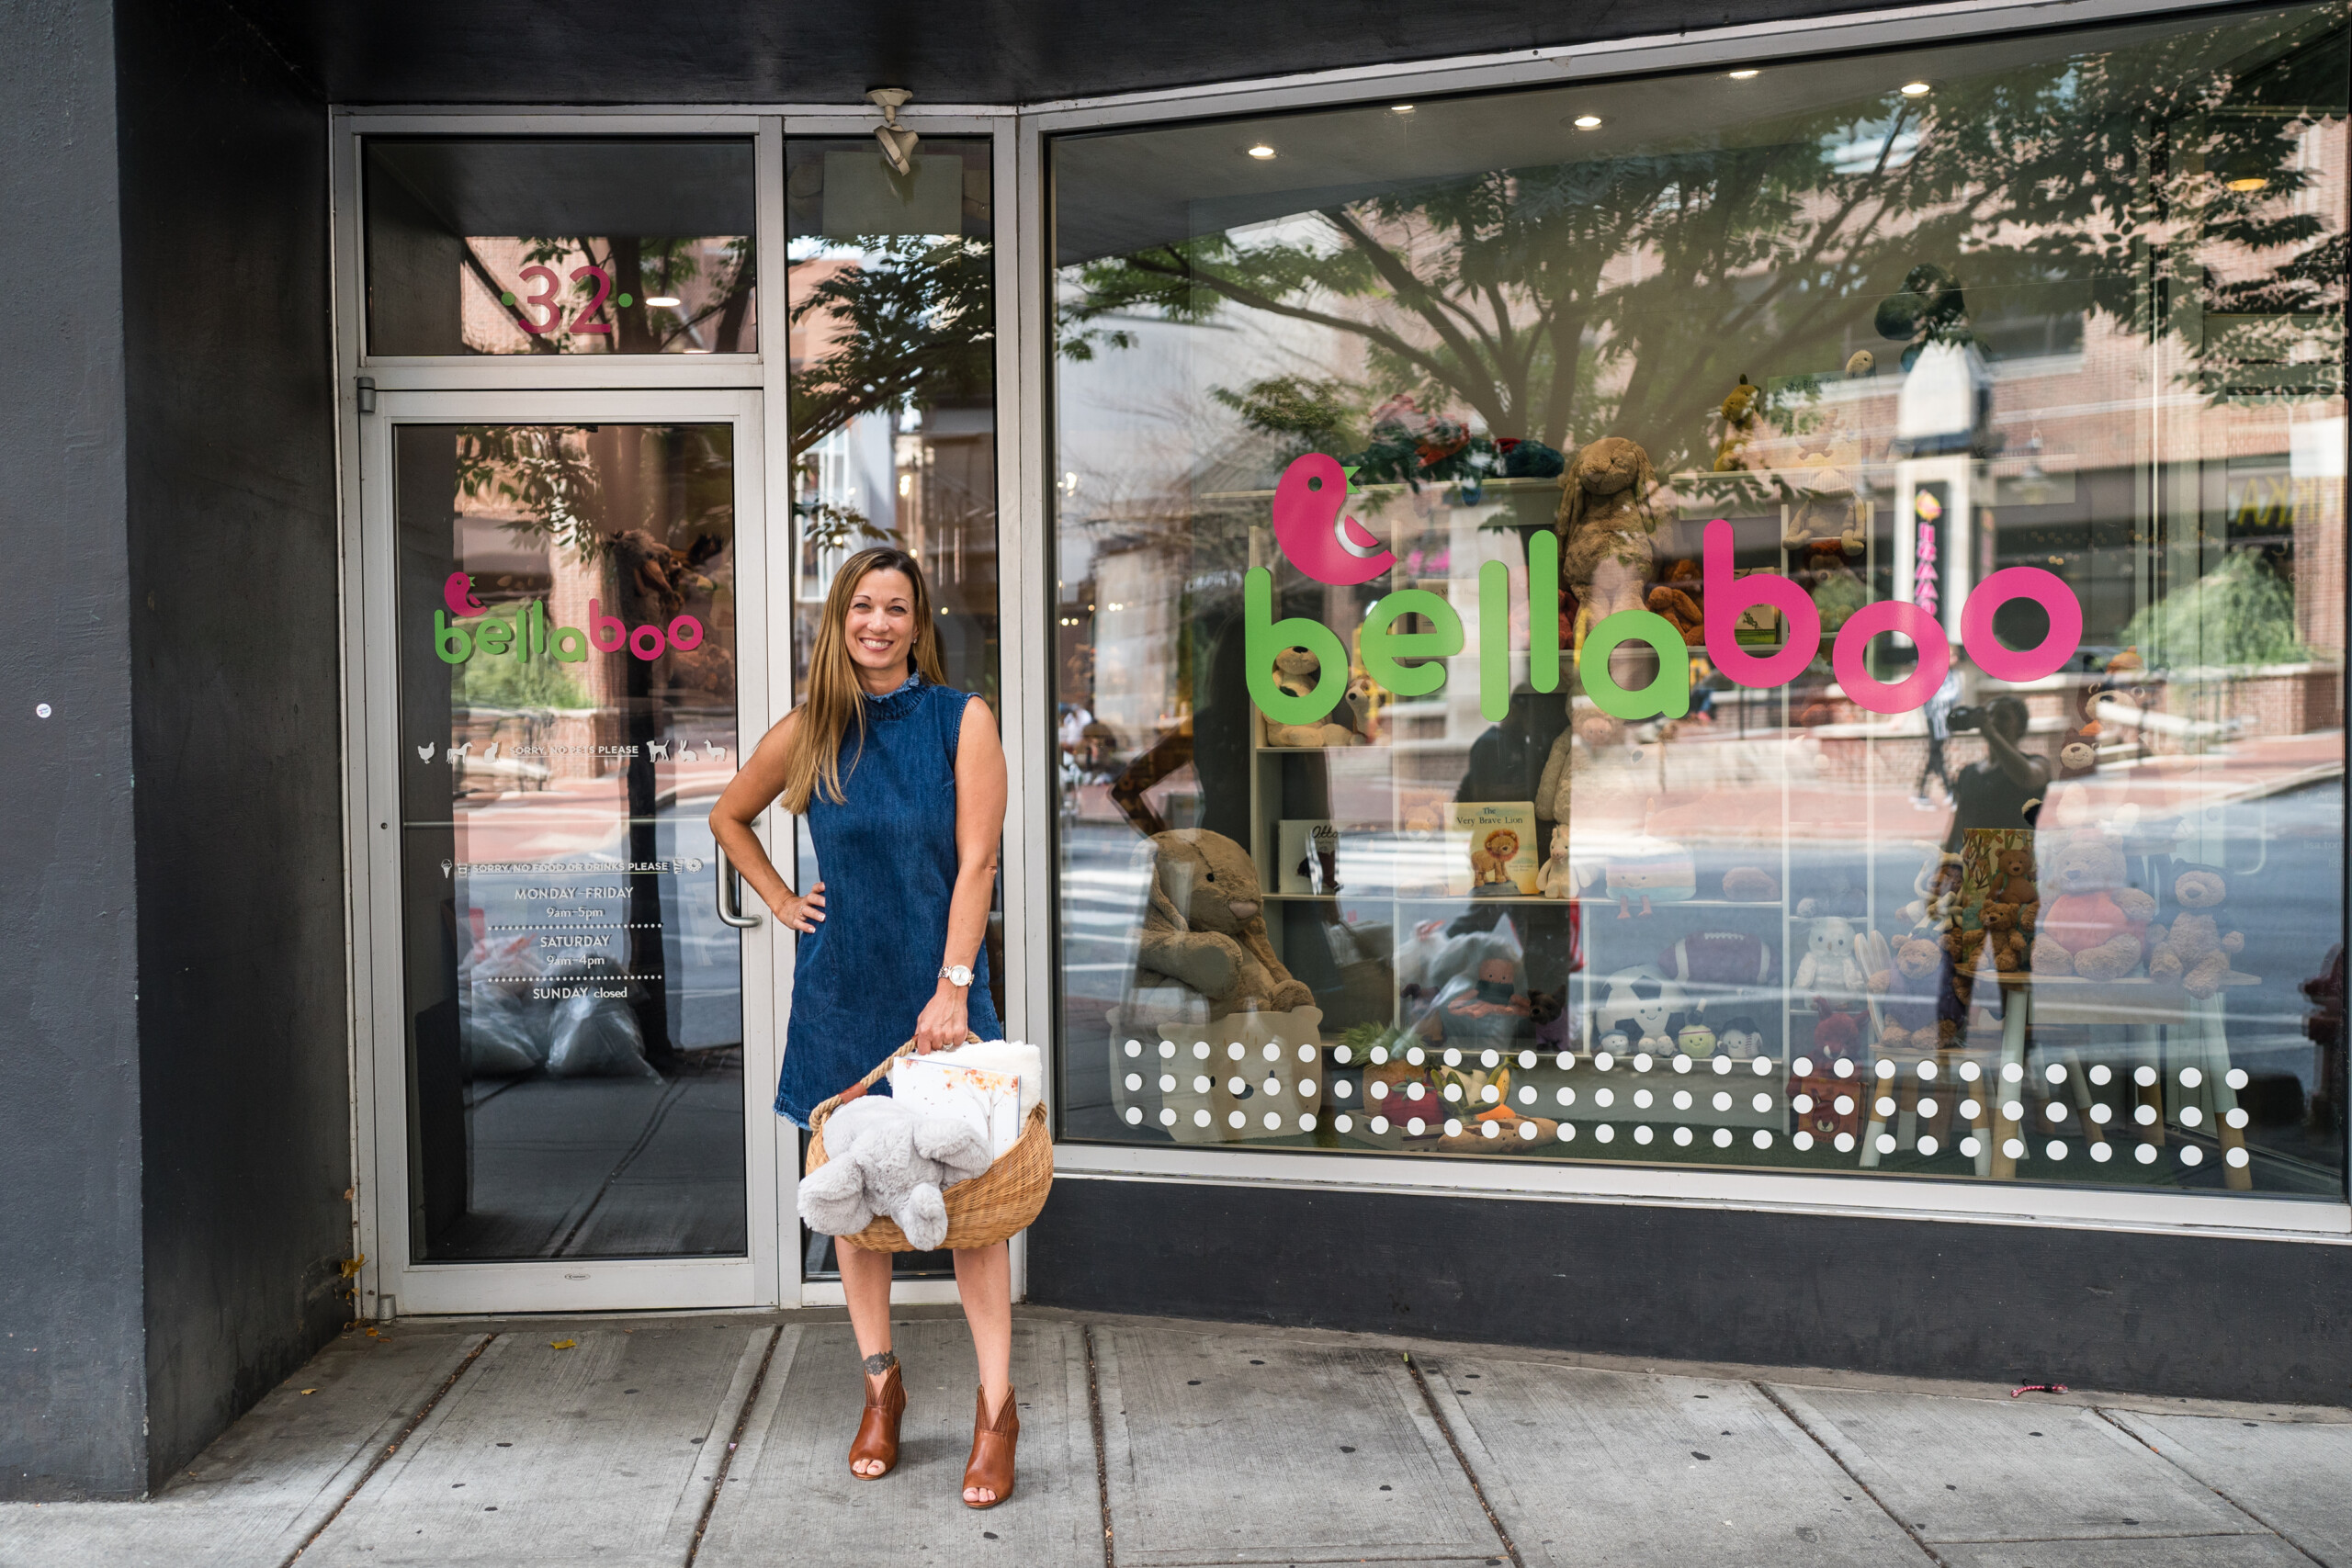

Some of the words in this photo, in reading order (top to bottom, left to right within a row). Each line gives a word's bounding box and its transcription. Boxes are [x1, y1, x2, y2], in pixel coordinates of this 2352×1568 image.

[518, 265, 612, 334] 32
[1244, 519, 2084, 724] bellaboo
[435, 598, 704, 664] bellaboo
[549, 746, 568, 754] NO
[571, 746, 595, 754] PETS
[598, 745, 639, 753] PLEASE
[1482, 807, 1497, 815] The
[1456, 817, 1475, 827] Very
[1505, 816, 1523, 824] Lion
[1312, 825, 1339, 839] Otto
[532, 863, 565, 872] FOOD
[567, 863, 582, 872] OR
[585, 863, 625, 872] DRINKS
[628, 863, 668, 871] PLEASE
[540, 935, 611, 948] SATURDAY
[533, 987, 589, 999] SUNDAY
[594, 987, 628, 998] closed
